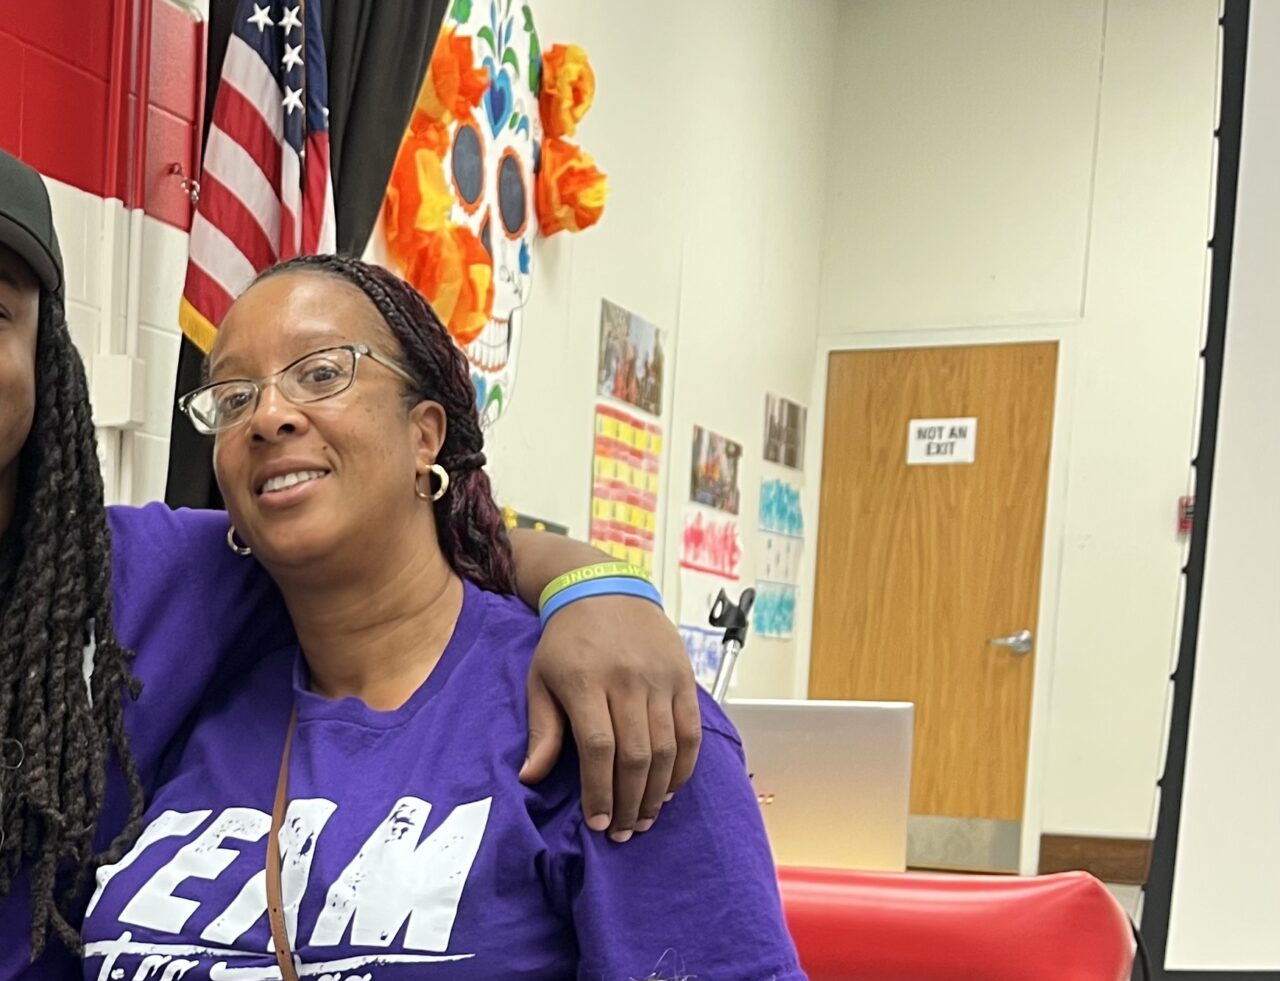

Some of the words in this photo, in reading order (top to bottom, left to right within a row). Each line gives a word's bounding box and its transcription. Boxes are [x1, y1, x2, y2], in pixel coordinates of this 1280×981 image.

[916, 426, 945, 441] NOT
[948, 425, 968, 440] AN
[925, 441, 956, 456] EXIT
[562, 566, 604, 586] DONE
[86, 796, 492, 951] TEAM
